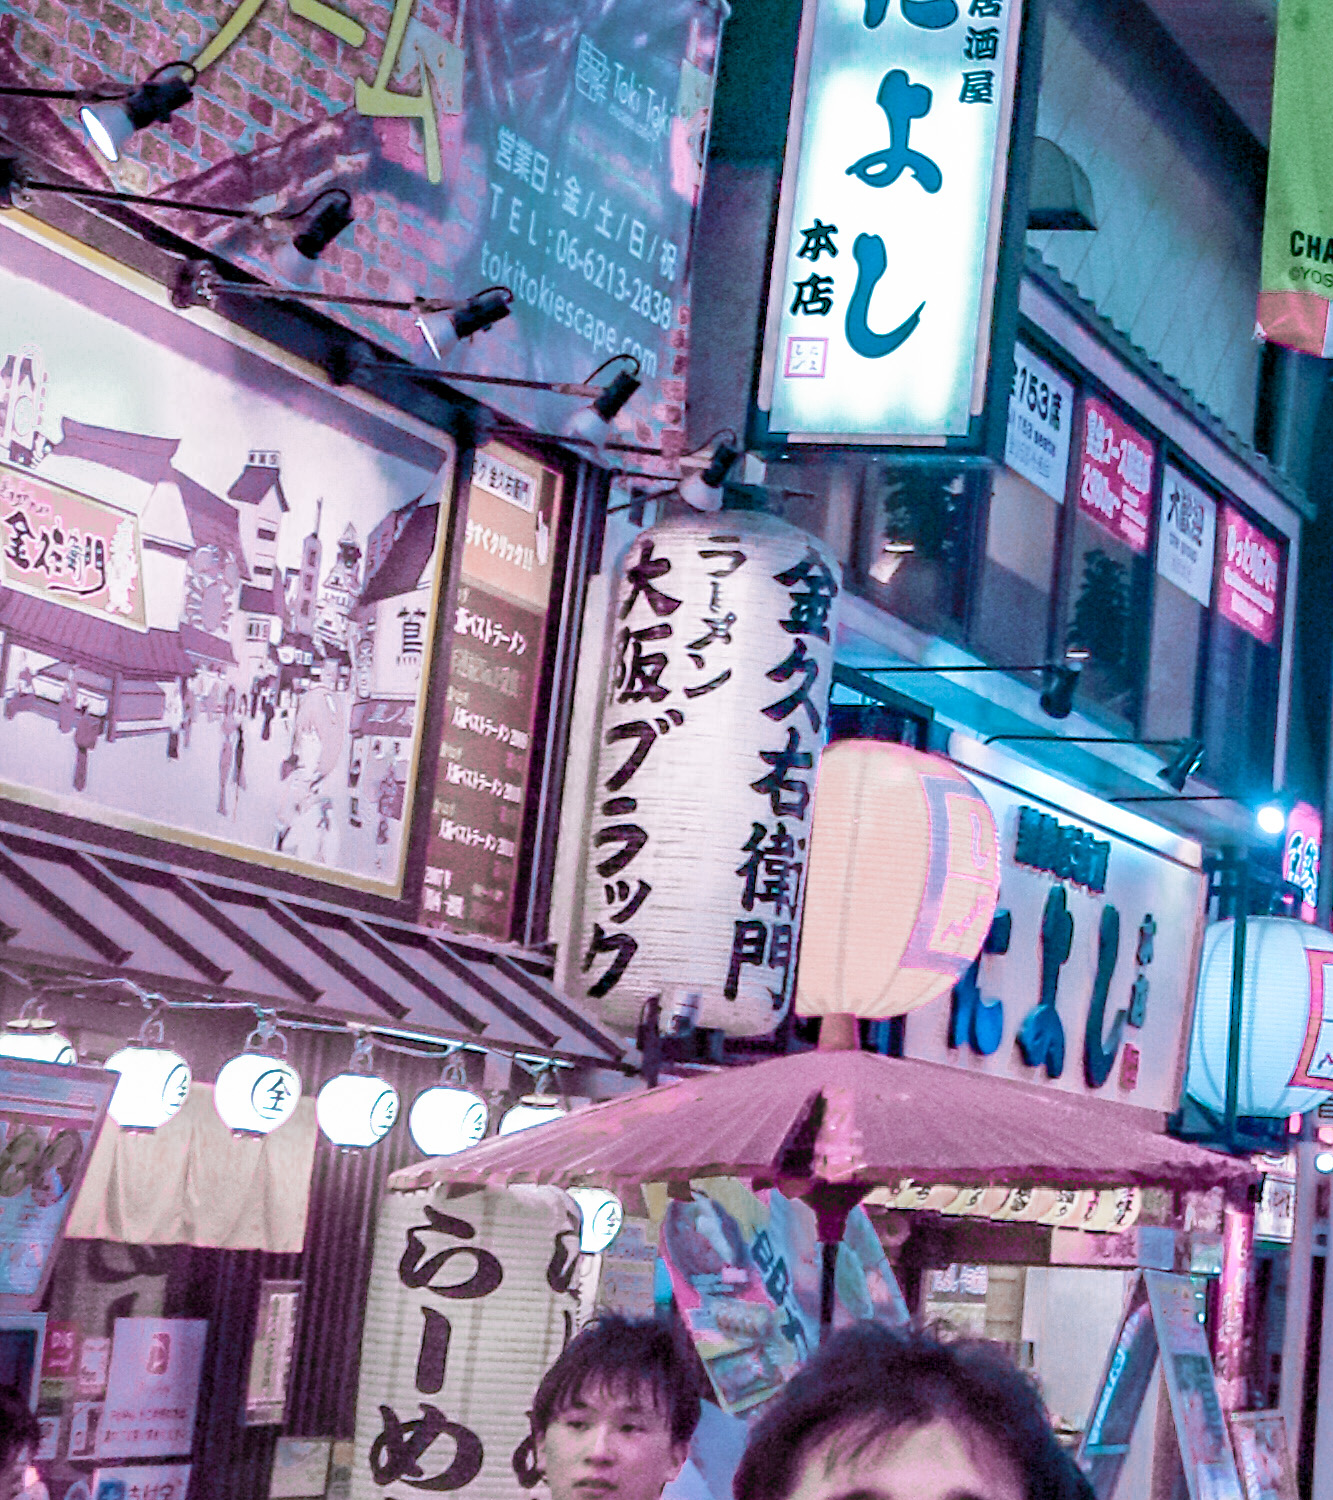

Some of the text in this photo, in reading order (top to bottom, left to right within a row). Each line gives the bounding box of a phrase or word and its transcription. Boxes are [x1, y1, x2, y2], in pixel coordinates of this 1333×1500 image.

[790, 218, 838, 318] 本店
[582, 541, 683, 999] 大阪ブラック
[684, 534, 747, 699] ラーメン
[726, 547, 839, 1011] 金久右衛門
